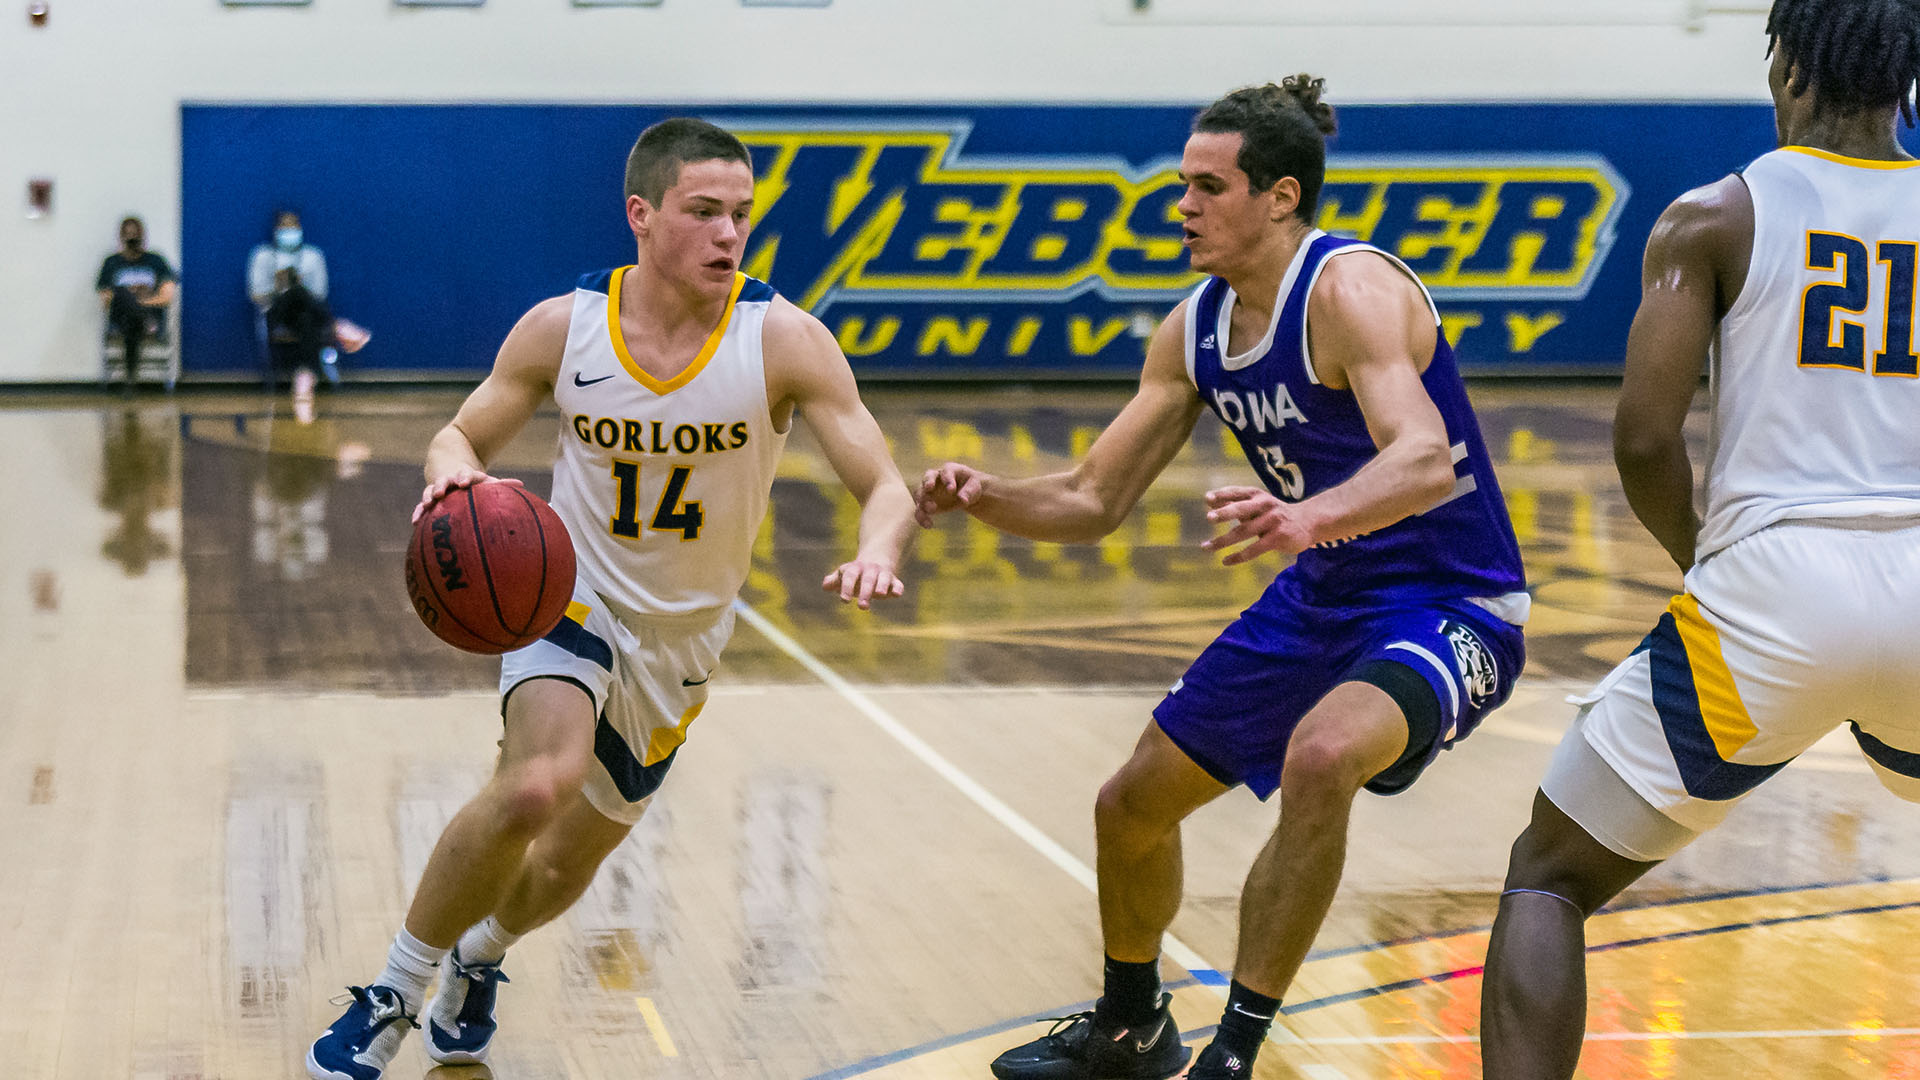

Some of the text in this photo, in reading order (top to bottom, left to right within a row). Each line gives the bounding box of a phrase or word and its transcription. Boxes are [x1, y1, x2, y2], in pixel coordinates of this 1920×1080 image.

[1797, 229, 1920, 378] 21
[836, 315, 1566, 354] UNIVTY
[573, 413, 750, 455] GORLOKS
[1212, 383, 1309, 433] IOWA
[1257, 446, 1305, 500] 13
[609, 458, 706, 543] 14
[431, 512, 470, 592] NCAA
